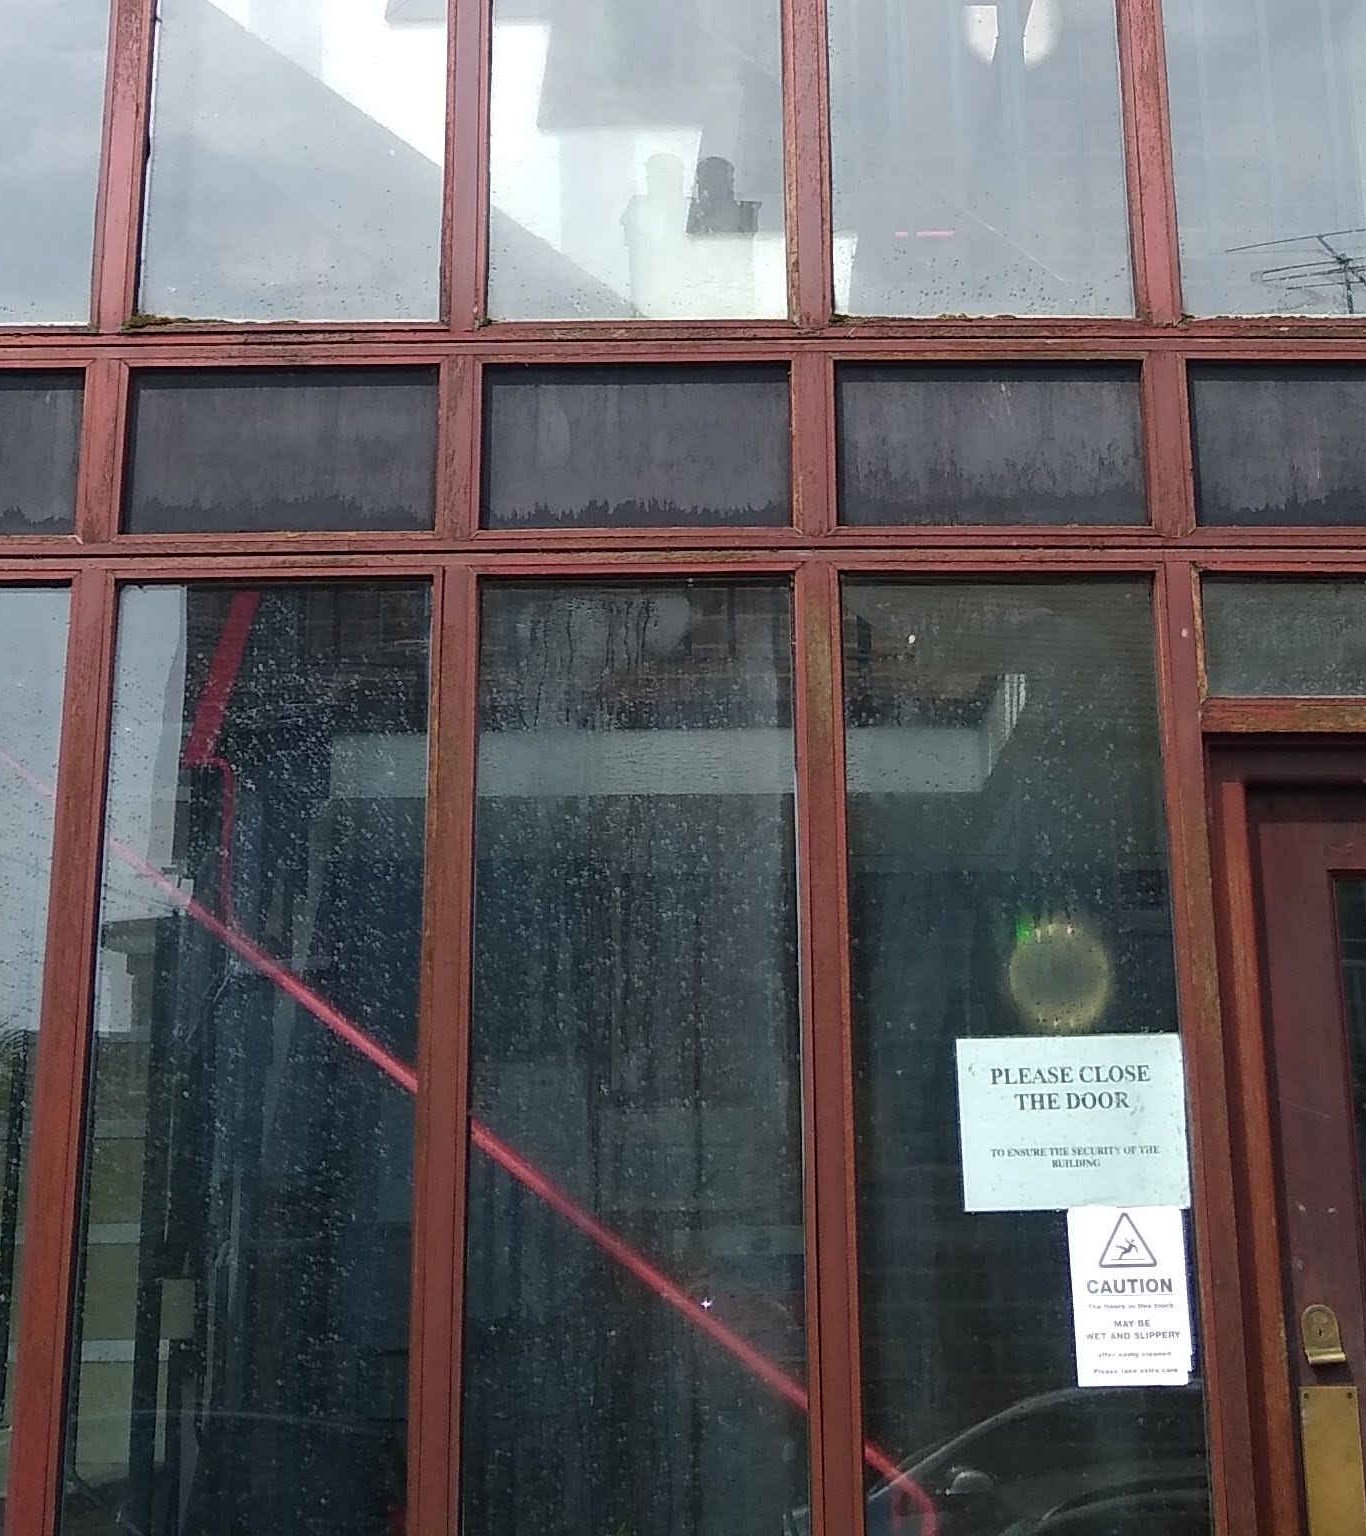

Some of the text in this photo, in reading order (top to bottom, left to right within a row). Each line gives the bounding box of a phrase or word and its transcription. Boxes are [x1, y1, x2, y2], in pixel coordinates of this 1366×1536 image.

[990, 1065, 1151, 1085] PLEASE CLOSE
[1014, 1092, 1129, 1110] THE DOOR
[991, 1145, 1160, 1158] TO ENSURE THE SECURITY OF THE
[1052, 1159, 1100, 1168] BUILDING
[1087, 1278, 1173, 1294] CAUTION
[1111, 1332, 1131, 1340] AND
[1134, 1331, 1180, 1339] SLIPPERY
